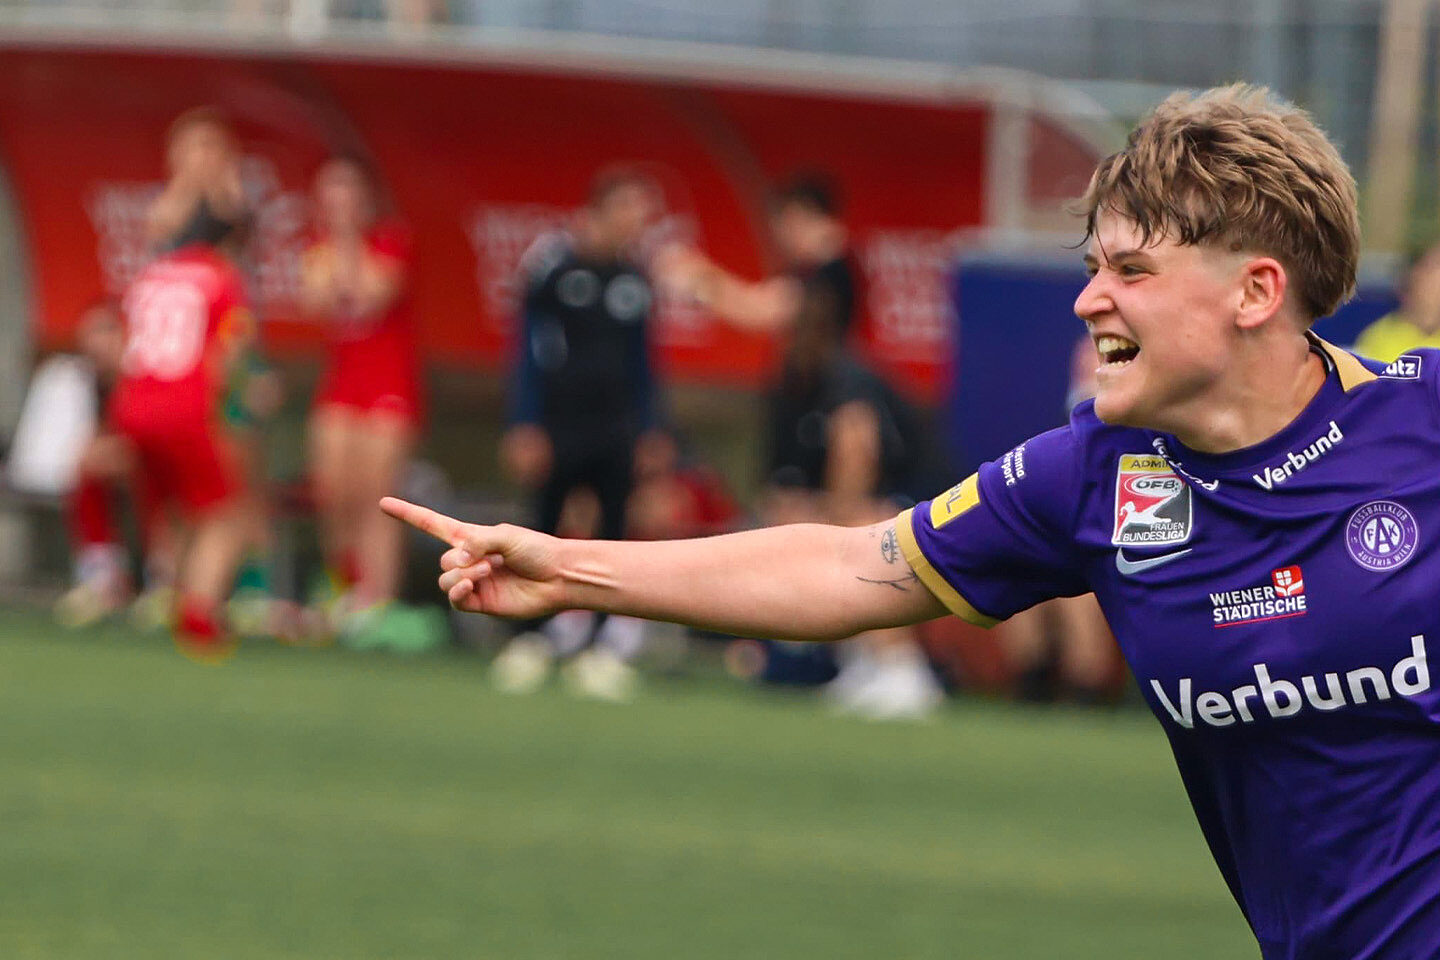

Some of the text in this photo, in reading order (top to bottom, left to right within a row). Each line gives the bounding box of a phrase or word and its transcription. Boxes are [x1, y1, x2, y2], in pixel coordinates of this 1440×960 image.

[1381, 359, 1416, 376] utz
[1253, 420, 1344, 491] Verbund
[1150, 522, 1185, 531] FRAUEN
[1350, 504, 1408, 529] FUSSBALLKLUB
[1122, 530, 1185, 542] BUNDESLIGA
[1358, 543, 1412, 566] AUSTRIA WIEN
[1209, 586, 1276, 607] WIENER
[1213, 595, 1307, 622] STÄDTISCHE
[1150, 634, 1431, 729] Verbund
